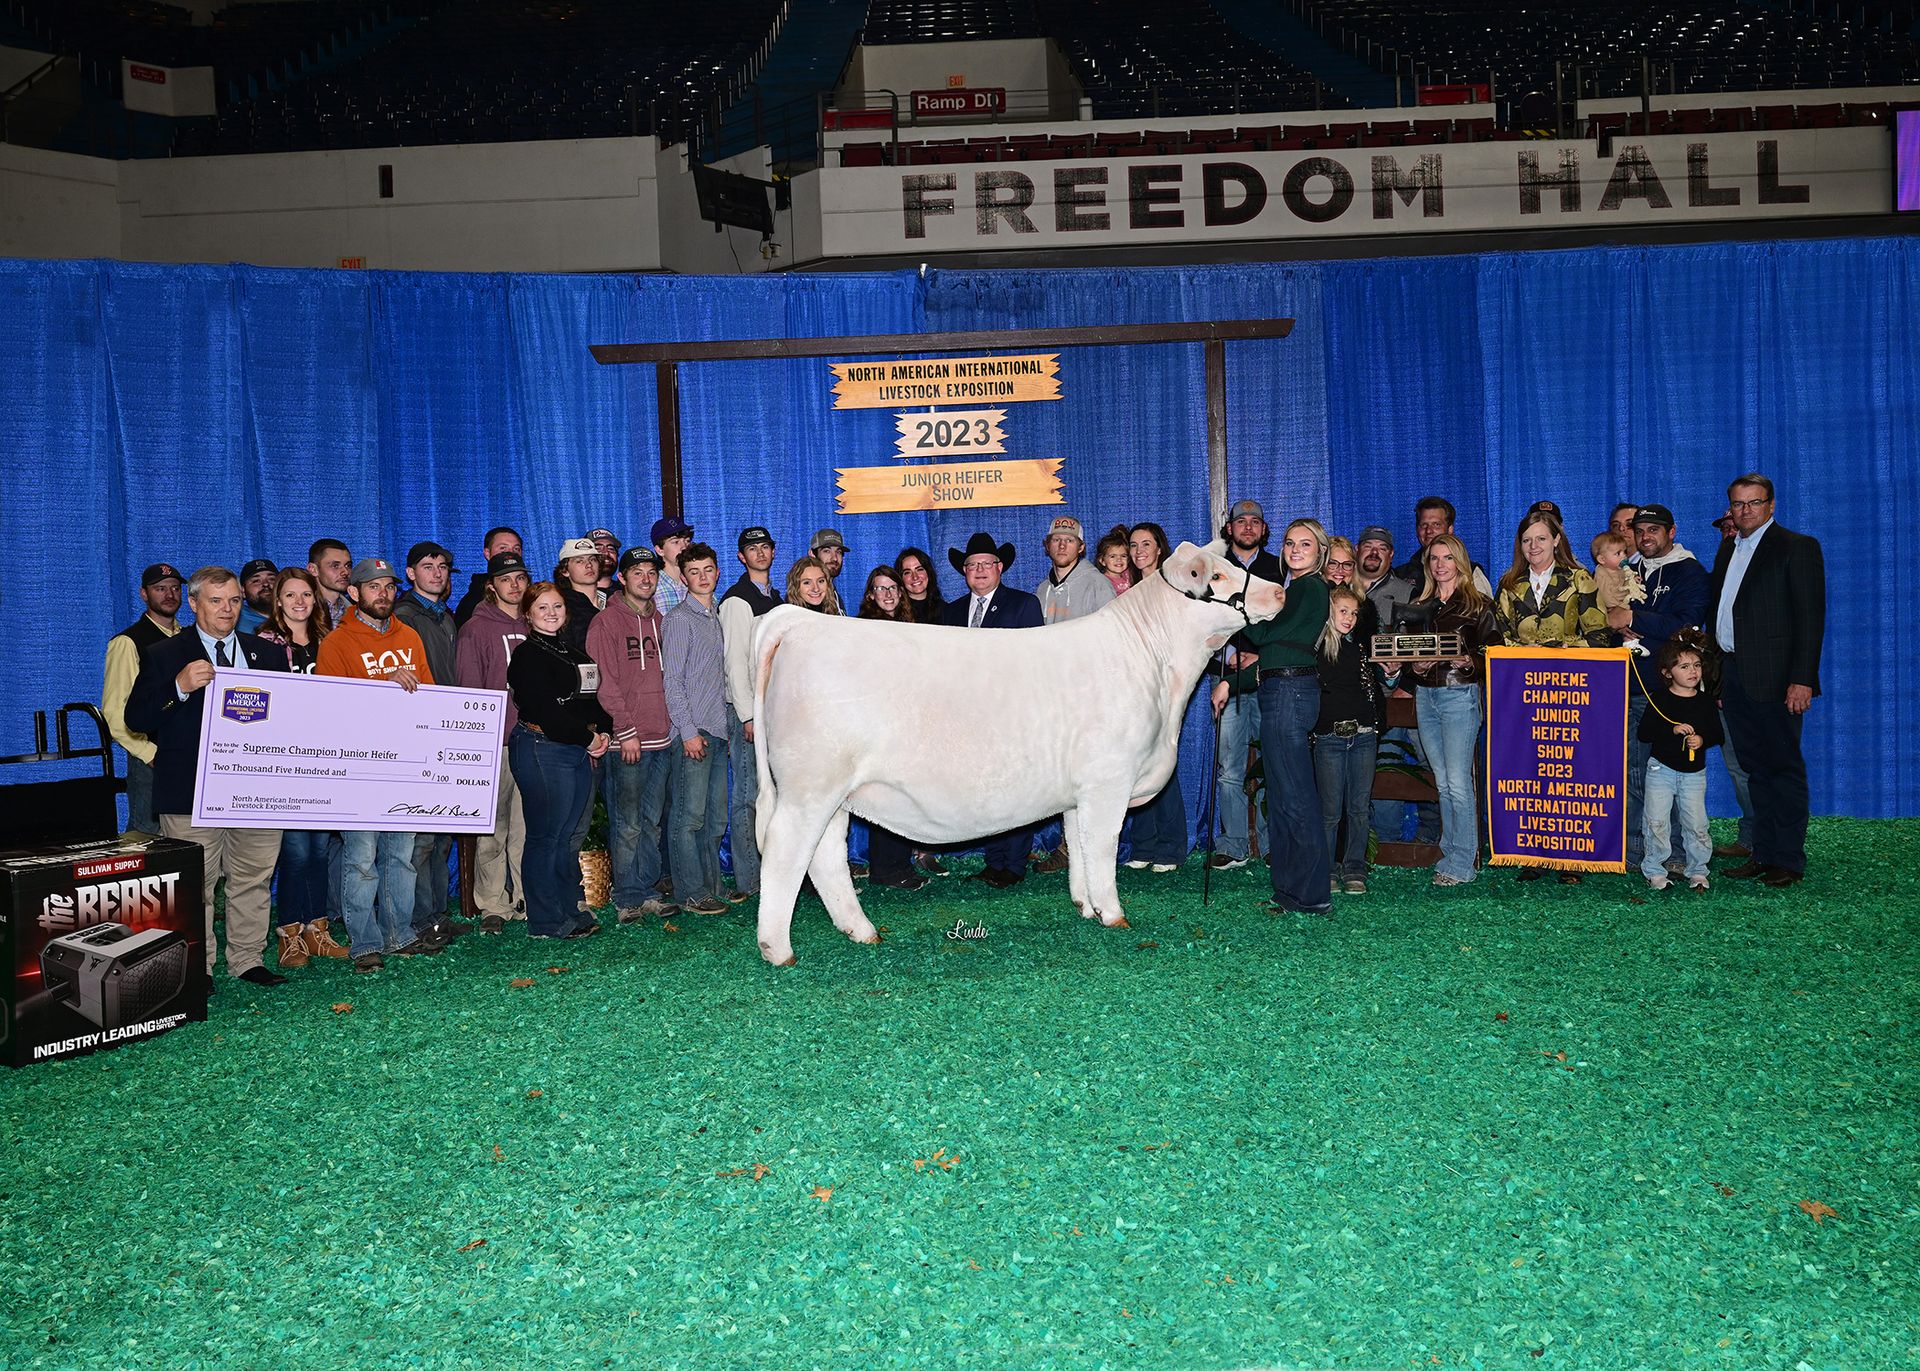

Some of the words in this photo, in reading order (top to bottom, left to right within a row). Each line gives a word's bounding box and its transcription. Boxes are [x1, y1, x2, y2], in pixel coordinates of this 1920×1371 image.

[917, 94, 966, 111] Ramp
[902, 153, 1444, 239] FREEDOM
[1518, 139, 1810, 214] HALL
[848, 366, 885, 382] NORTH
[891, 364, 949, 380] AMERICAN
[955, 360, 1044, 378] INTERNATIONAL
[879, 384, 941, 400] LIVESTOCK
[947, 381, 1014, 397] EXPOSITION
[916, 418, 990, 448] 2023
[901, 472, 951, 487] JUNIOR
[956, 469, 1003, 484] HEIFER
[932, 487, 974, 501] SHOW
[1525, 672, 1588, 687] SUPREME
[227, 699, 266, 707] AMERICAN
[233, 692, 260, 701] NORTH
[1523, 690, 1590, 705] CHAMPION
[464, 701, 496, 712] 0050
[1532, 708, 1580, 724] JUNIOR
[441, 720, 486, 731] 11/12/2023
[1532, 726, 1580, 742] HEIFER
[243, 743, 286, 755] Supreme
[289, 746, 337, 758] Champion
[339, 748, 368, 759] Junior
[371, 750, 398, 760] Heifer
[437, 751, 443, 762] $
[448, 752, 482, 762] 2,500.00
[1537, 745, 1574, 760] SHOW
[213, 763, 230, 771] Two
[232, 764, 273, 773] Thousand
[275, 765, 292, 774] Five
[294, 767, 329, 775] Hundred
[1538, 763, 1573, 778] 2023
[1498, 780, 1541, 795] NORTH
[1548, 783, 1615, 799] AMERICAN
[265, 803, 301, 811] Exposition
[288, 797, 331, 805] International
[1505, 797, 1608, 817] INTERNATIONAL
[1519, 816, 1592, 834] LIVESTOCK
[1517, 834, 1594, 852] EXPOSITION
[78, 863, 112, 877] SULLIVAN
[115, 859, 141, 871] SUPPLY
[75, 872, 181, 929] BEAST
[156, 1013, 187, 1026] LIVESTOCK
[34, 1033, 100, 1059] INDUSTRY
[102, 1020, 156, 1043] LEADING
